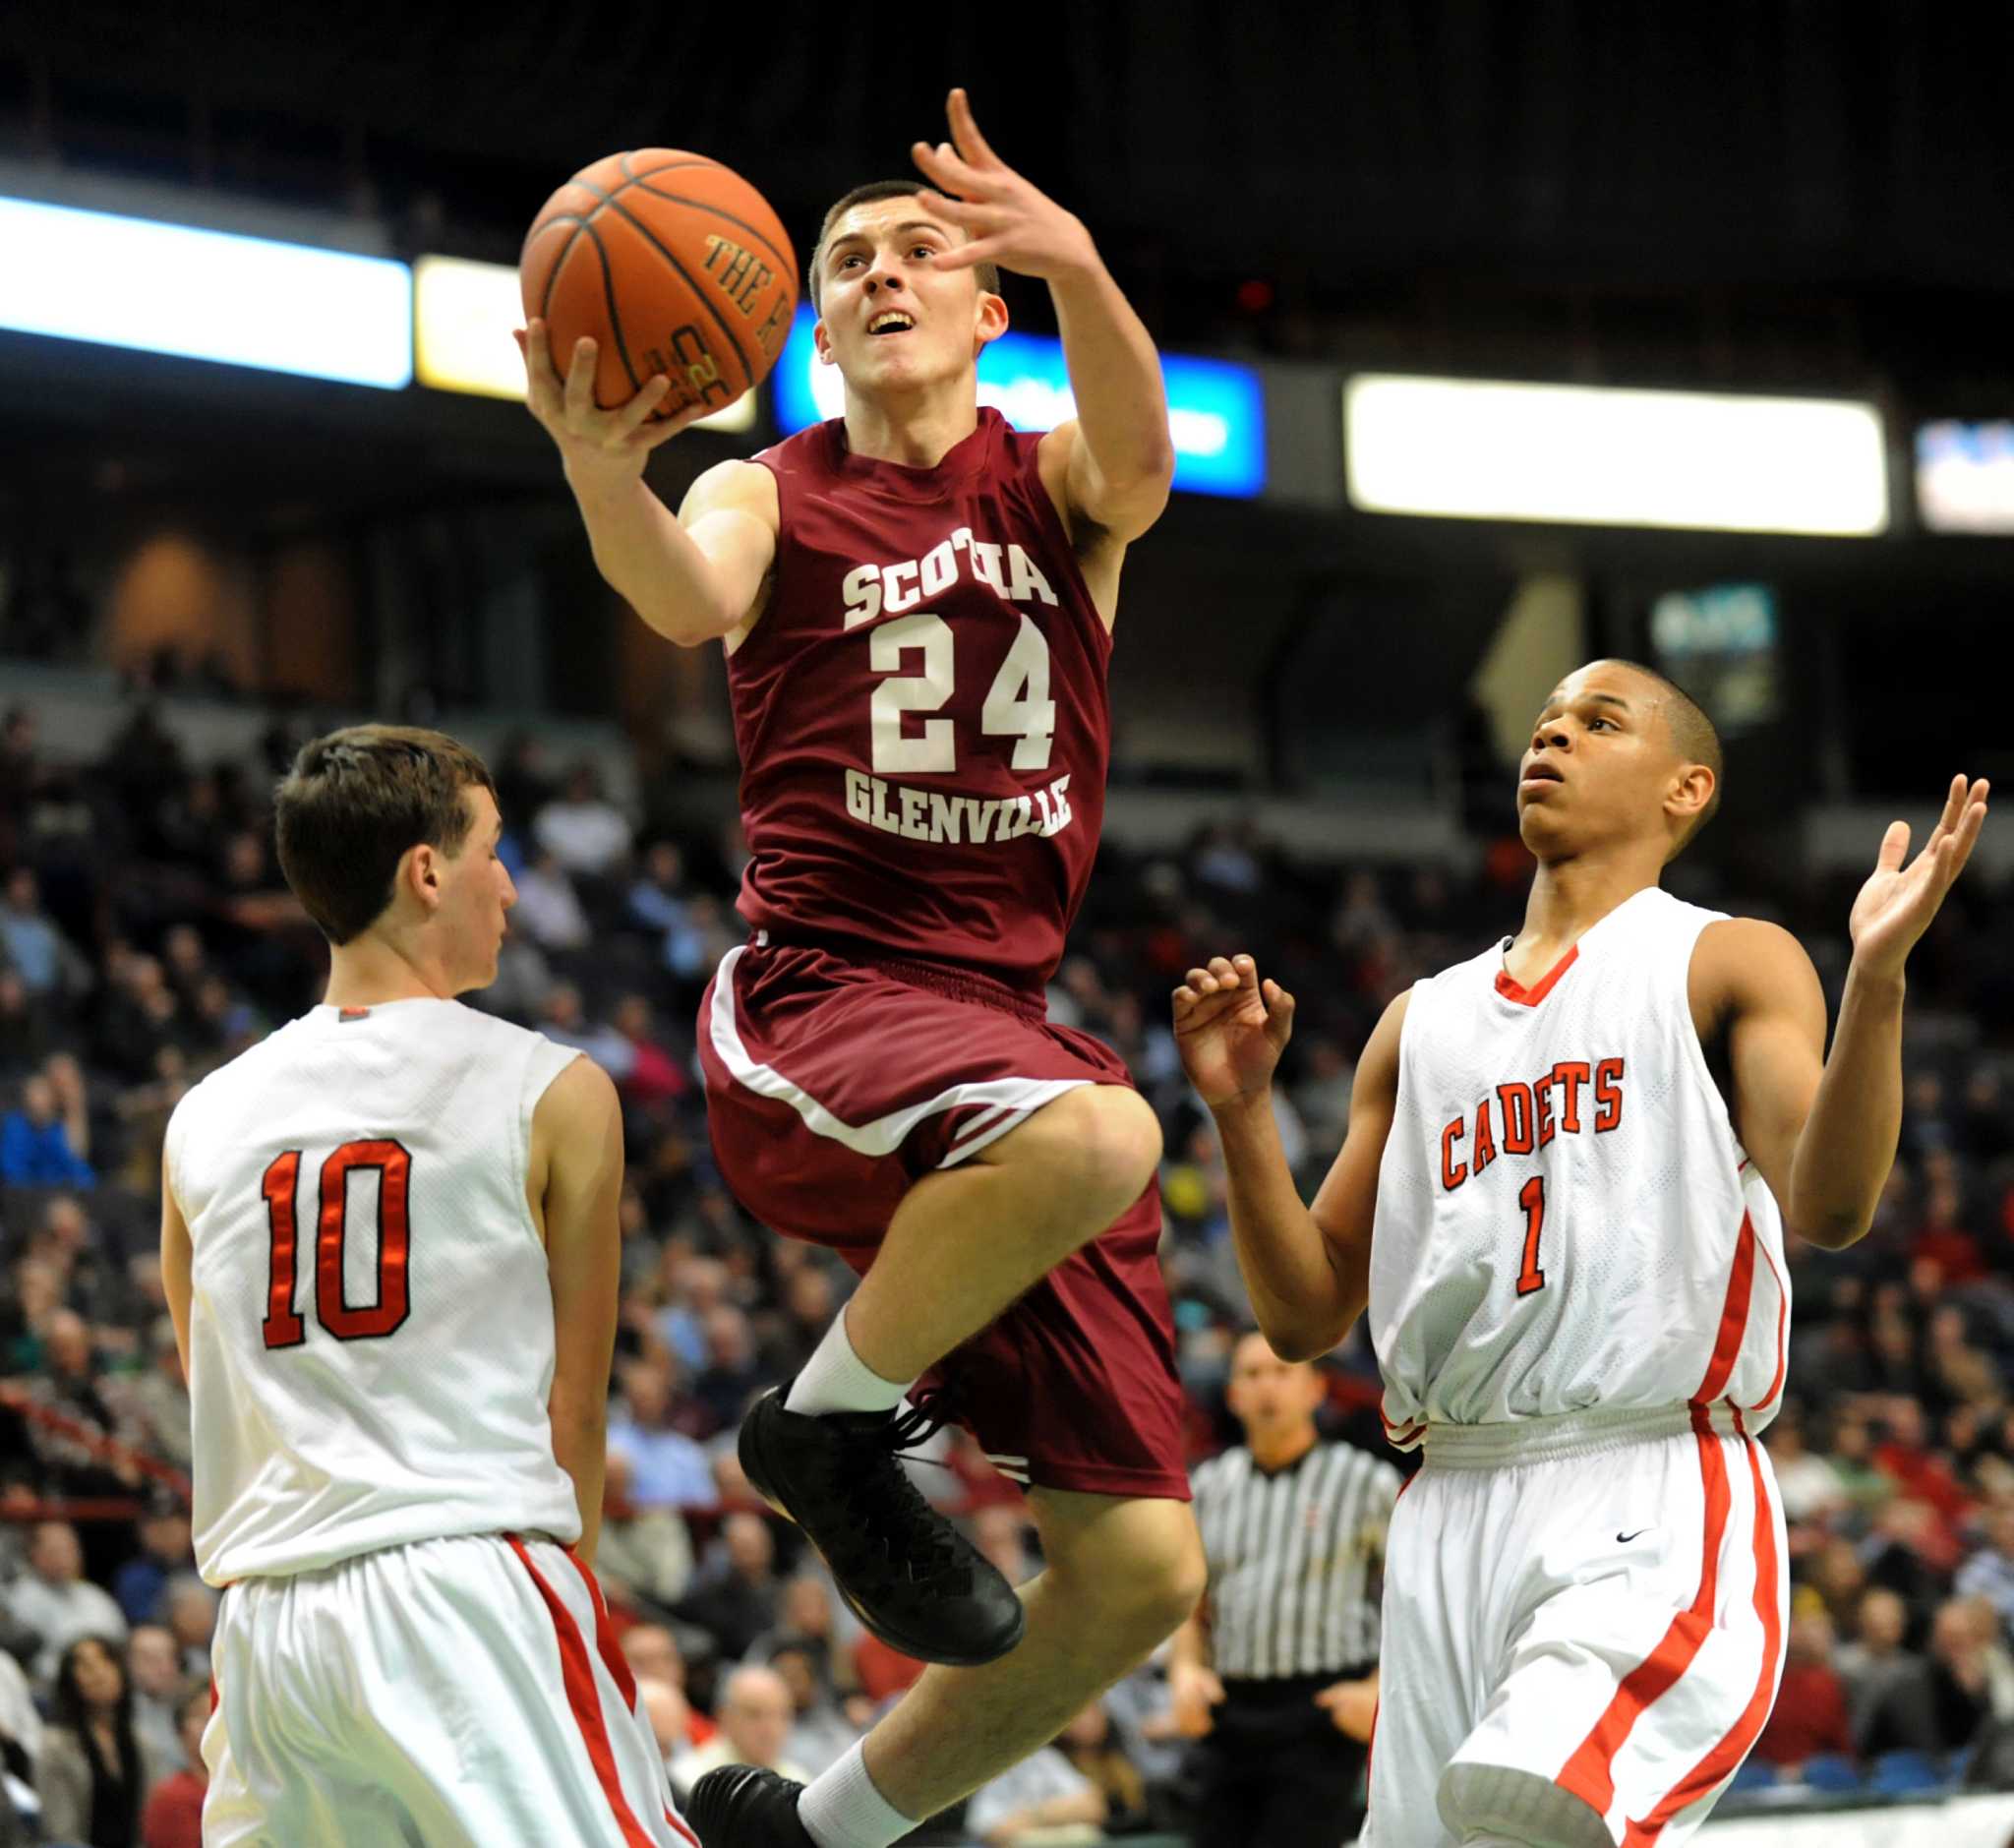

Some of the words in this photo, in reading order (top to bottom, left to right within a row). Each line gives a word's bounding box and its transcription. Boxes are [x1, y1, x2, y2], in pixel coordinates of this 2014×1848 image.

[702, 233, 775, 320] THE
[843, 527, 1059, 631] SCOTIA
[870, 614, 1055, 773] 24
[846, 768, 1072, 844] GLENVILLE
[1441, 1057, 1624, 1192] CADETS
[262, 1139, 412, 1349] 10
[1515, 1175, 1545, 1298] 1
